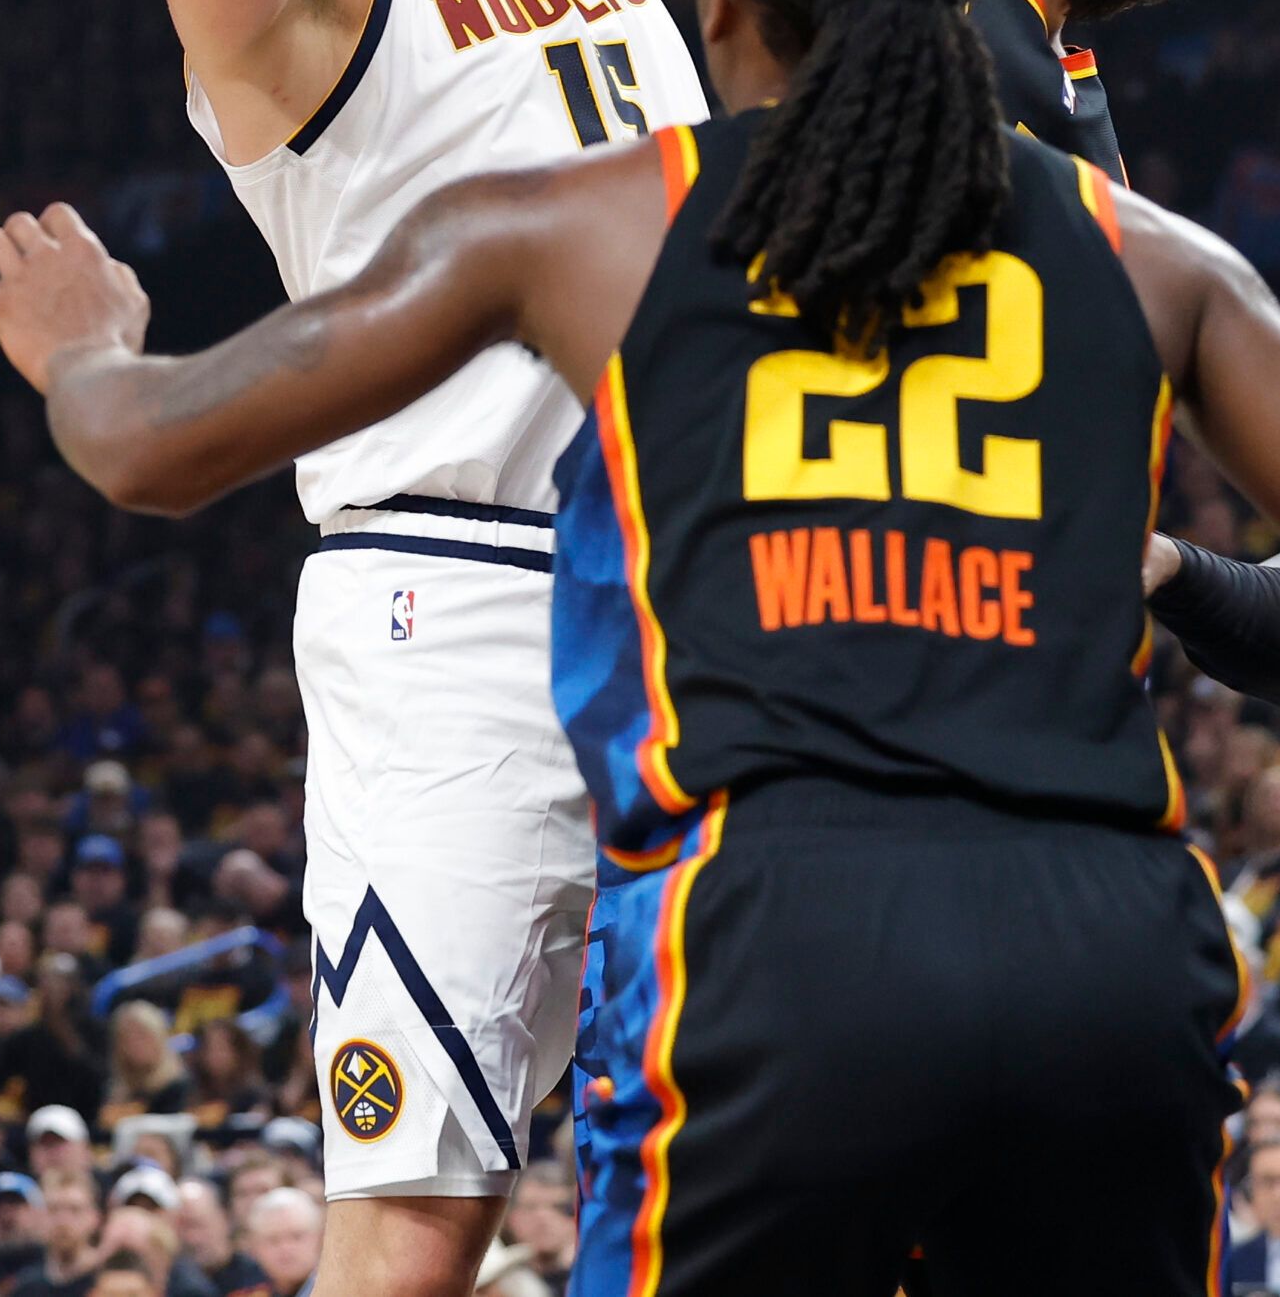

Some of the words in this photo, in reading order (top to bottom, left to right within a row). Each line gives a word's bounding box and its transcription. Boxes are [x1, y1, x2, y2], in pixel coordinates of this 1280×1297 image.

[541, 37, 651, 151] 15
[742, 249, 1044, 520] 22
[748, 526, 1037, 647] WALLACE
